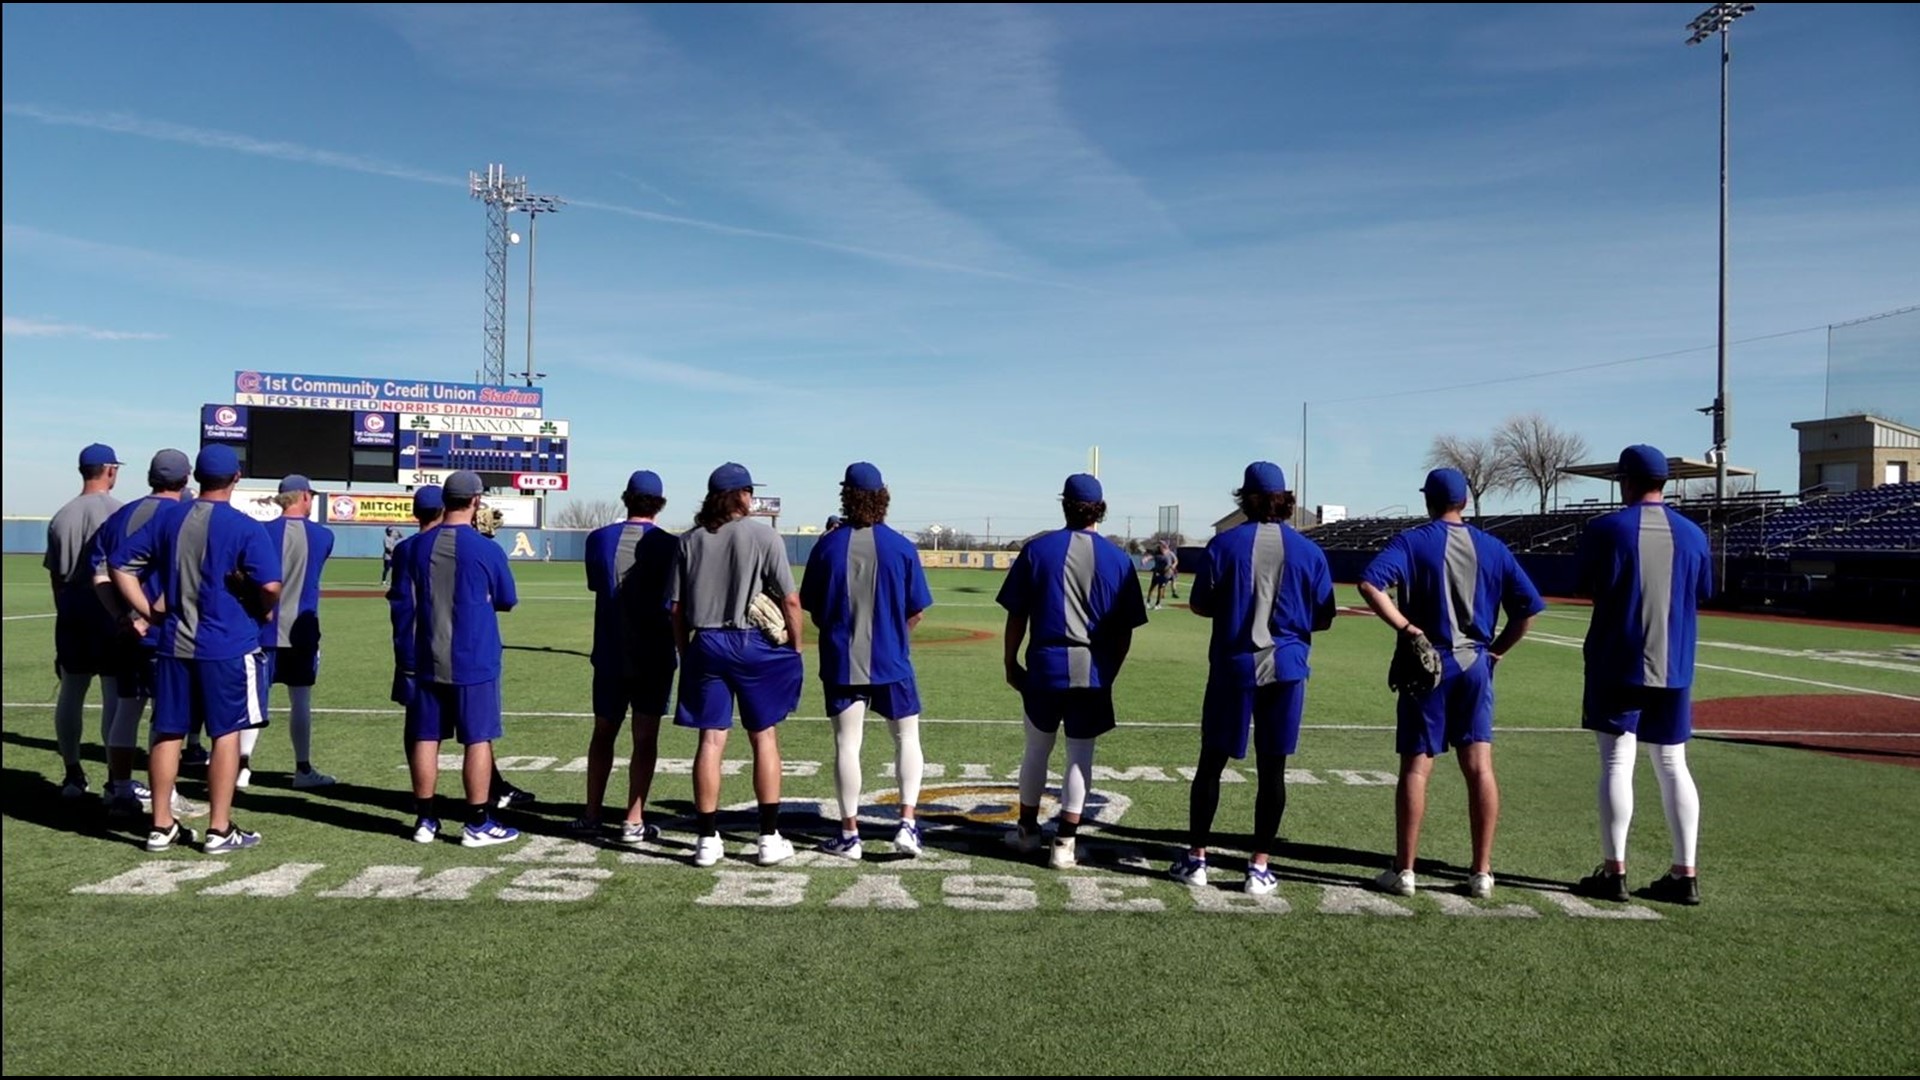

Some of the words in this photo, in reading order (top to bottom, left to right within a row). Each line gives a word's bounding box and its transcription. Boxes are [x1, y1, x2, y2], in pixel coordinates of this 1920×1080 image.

[263, 375, 287, 391] 1st
[291, 377, 379, 398] Community
[384, 382, 429, 398] Credit
[433, 386, 476, 401] Union
[479, 387, 540, 404] Stadium
[267, 395, 329, 408] FOSTER
[335, 398, 378, 410] FIELD
[382, 402, 439, 413] NORRIS
[444, 405, 514, 417] DIAMOND
[441, 416, 524, 432] SHANNON
